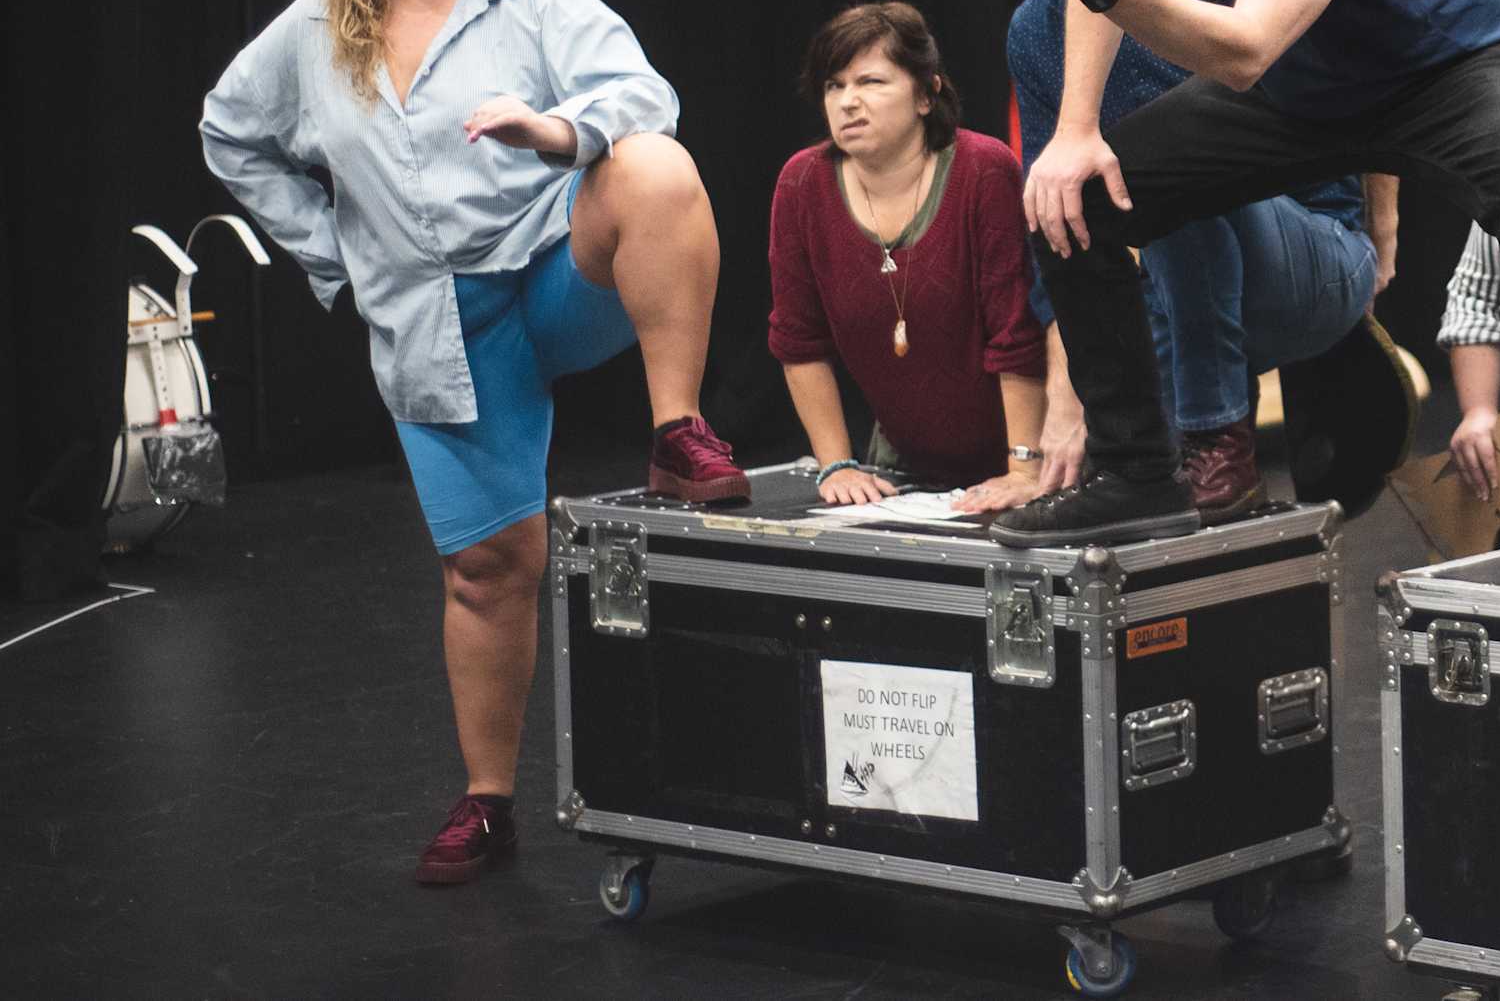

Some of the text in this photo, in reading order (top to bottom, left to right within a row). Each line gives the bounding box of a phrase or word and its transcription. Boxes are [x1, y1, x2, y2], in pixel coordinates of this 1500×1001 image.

[858, 688, 937, 710] DO NOT FLIP
[843, 713, 955, 737] MUST TRAVEL ON
[870, 741, 926, 760] WHEELS
